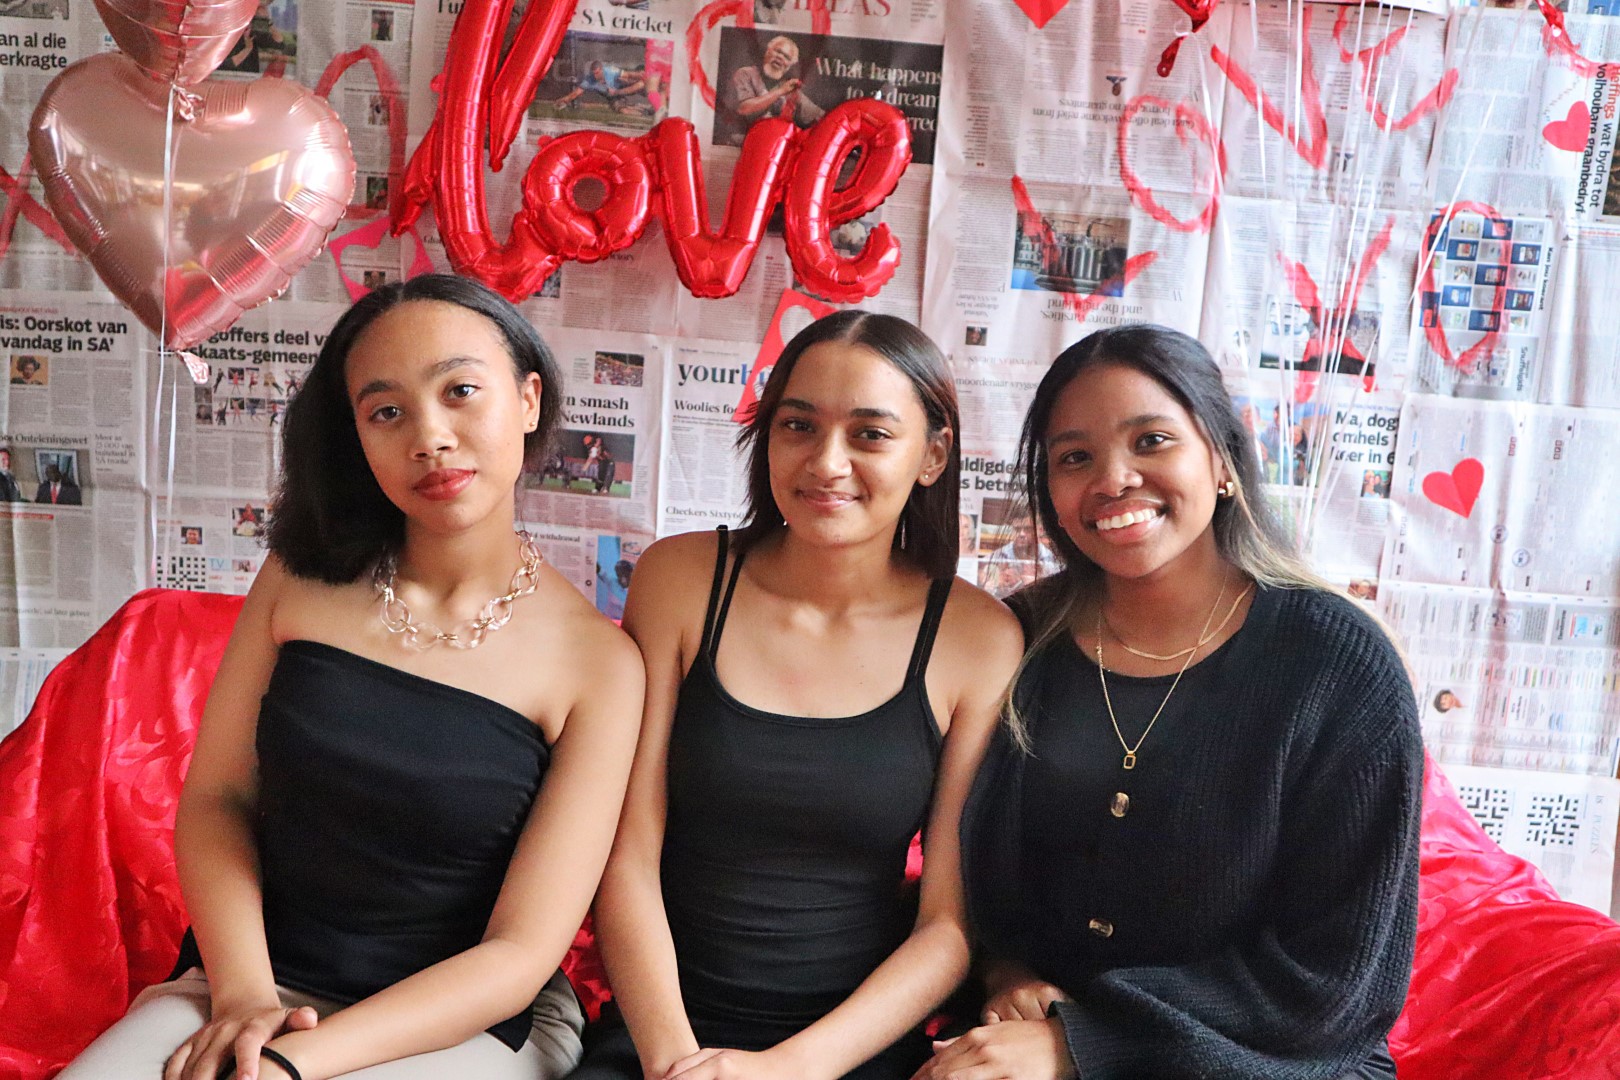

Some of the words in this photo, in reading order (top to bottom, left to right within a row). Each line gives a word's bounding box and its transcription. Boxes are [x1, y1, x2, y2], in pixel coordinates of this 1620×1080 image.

[581, 8, 605, 27] SA
[612, 14, 673, 34] cricket
[24, 32, 37, 48] al
[42, 32, 67, 49] die
[0, 51, 68, 71] erkragte
[815, 56, 864, 78] What
[870, 61, 943, 86] happens
[1589, 63, 1608, 135] volhoubare
[1603, 64, 1620, 120] Heffings
[1032, 107, 1055, 120] from
[1601, 122, 1613, 147] wat
[1575, 137, 1595, 213] graanbedryf
[1594, 149, 1610, 185] bydra
[1590, 186, 1606, 208] tot
[1101, 303, 1119, 314] the
[1121, 305, 1143, 315] and
[0, 315, 19, 331] is:
[24, 316, 92, 333] Oorskot
[97, 321, 127, 334] van
[0, 335, 62, 353] vandag
[67, 336, 83, 351] in
[274, 330, 310, 346] deel
[580, 397, 629, 411] smash
[674, 399, 720, 414] Woolies
[723, 404, 738, 414] fo
[560, 411, 635, 428] Newlands
[1369, 449, 1382, 464] in
[665, 505, 708, 517] Checkers
[210, 558, 225, 569] TV
